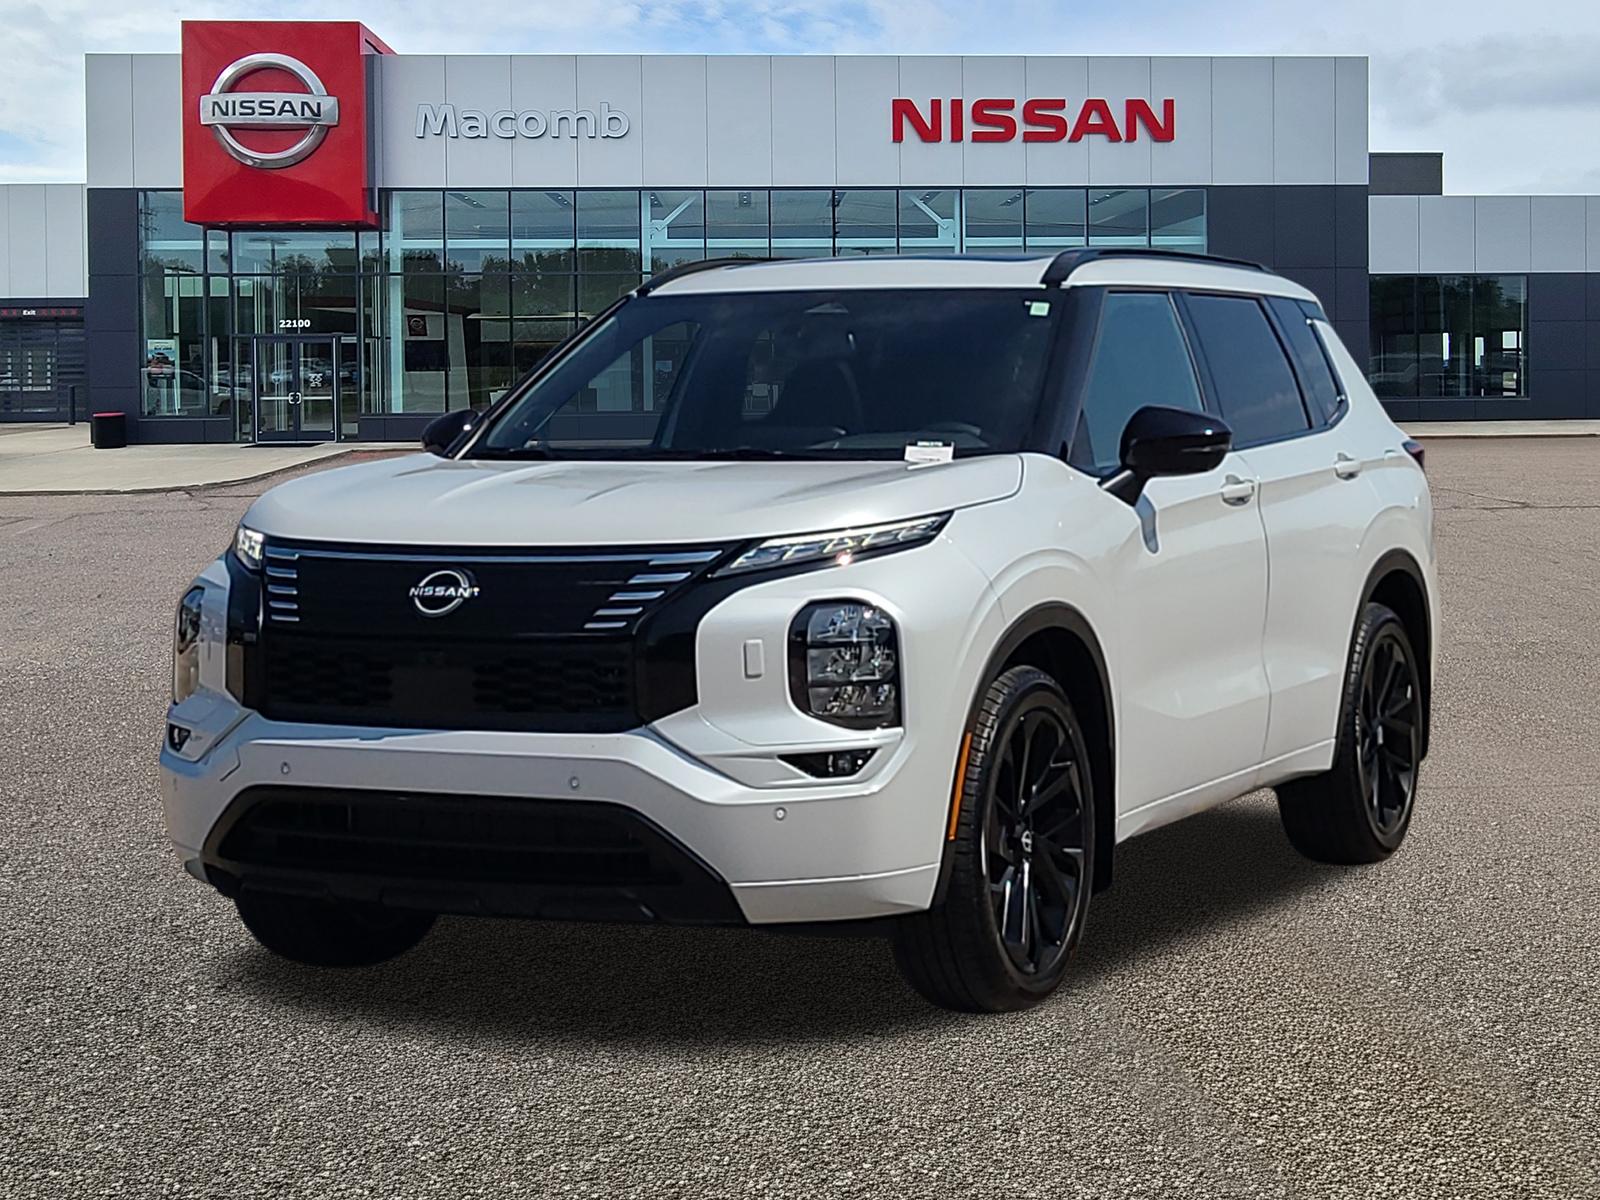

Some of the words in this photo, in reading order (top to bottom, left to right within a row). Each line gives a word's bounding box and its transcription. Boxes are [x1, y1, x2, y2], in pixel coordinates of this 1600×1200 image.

[212, 100, 322, 117] NISSAN
[415, 101, 630, 139] Macomb
[892, 98, 1175, 143] NISSAN
[279, 319, 311, 328] 22100
[409, 586, 471, 598] NISSAN
